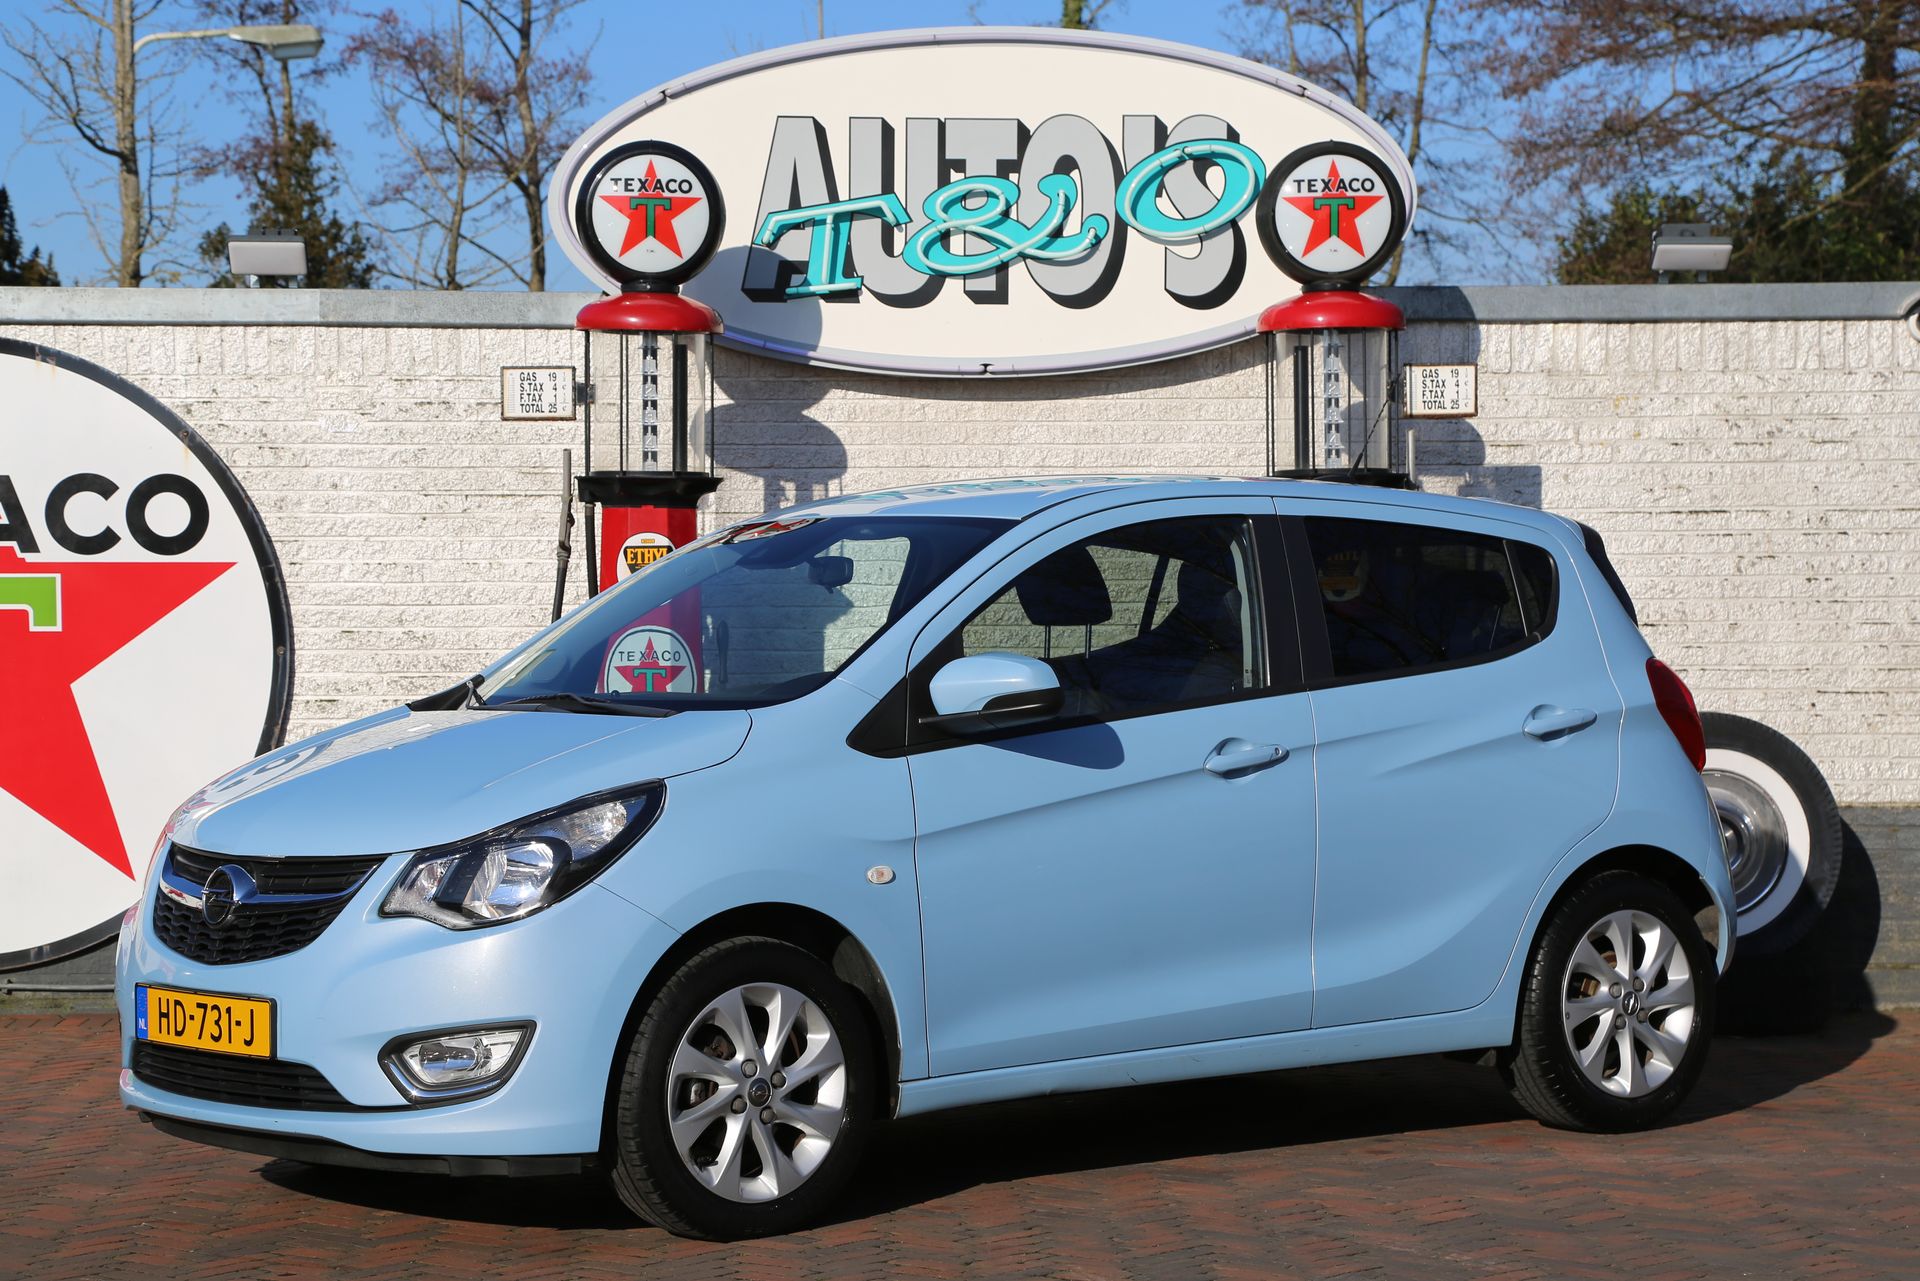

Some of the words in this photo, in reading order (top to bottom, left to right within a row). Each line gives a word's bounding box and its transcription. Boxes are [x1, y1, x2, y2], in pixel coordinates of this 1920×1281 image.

[610, 177, 693, 194] TEXACO
[1293, 177, 1375, 193] TEXACO
[629, 197, 672, 238] T
[1313, 197, 1355, 238] T
[520, 372, 537, 382] GAS
[548, 372, 556, 382] 19
[1422, 369, 1439, 378] GAS
[1451, 369, 1460, 378] 19
[520, 383, 544, 392] S.TAX
[1422, 380, 1446, 389] S.TAX
[520, 394, 542, 402] F.TAX
[1422, 390, 1445, 399] F.TAX
[520, 404, 544, 413] TOTAL
[548, 404, 558, 413] 25
[1422, 401, 1447, 410] TOTAL
[1450, 400, 1460, 410] 25
[618, 650, 681, 662] TEXACO
[632, 668, 667, 692] T
[138, 1017, 147, 1030] NL
[158, 997, 254, 1046] HD-731-J
